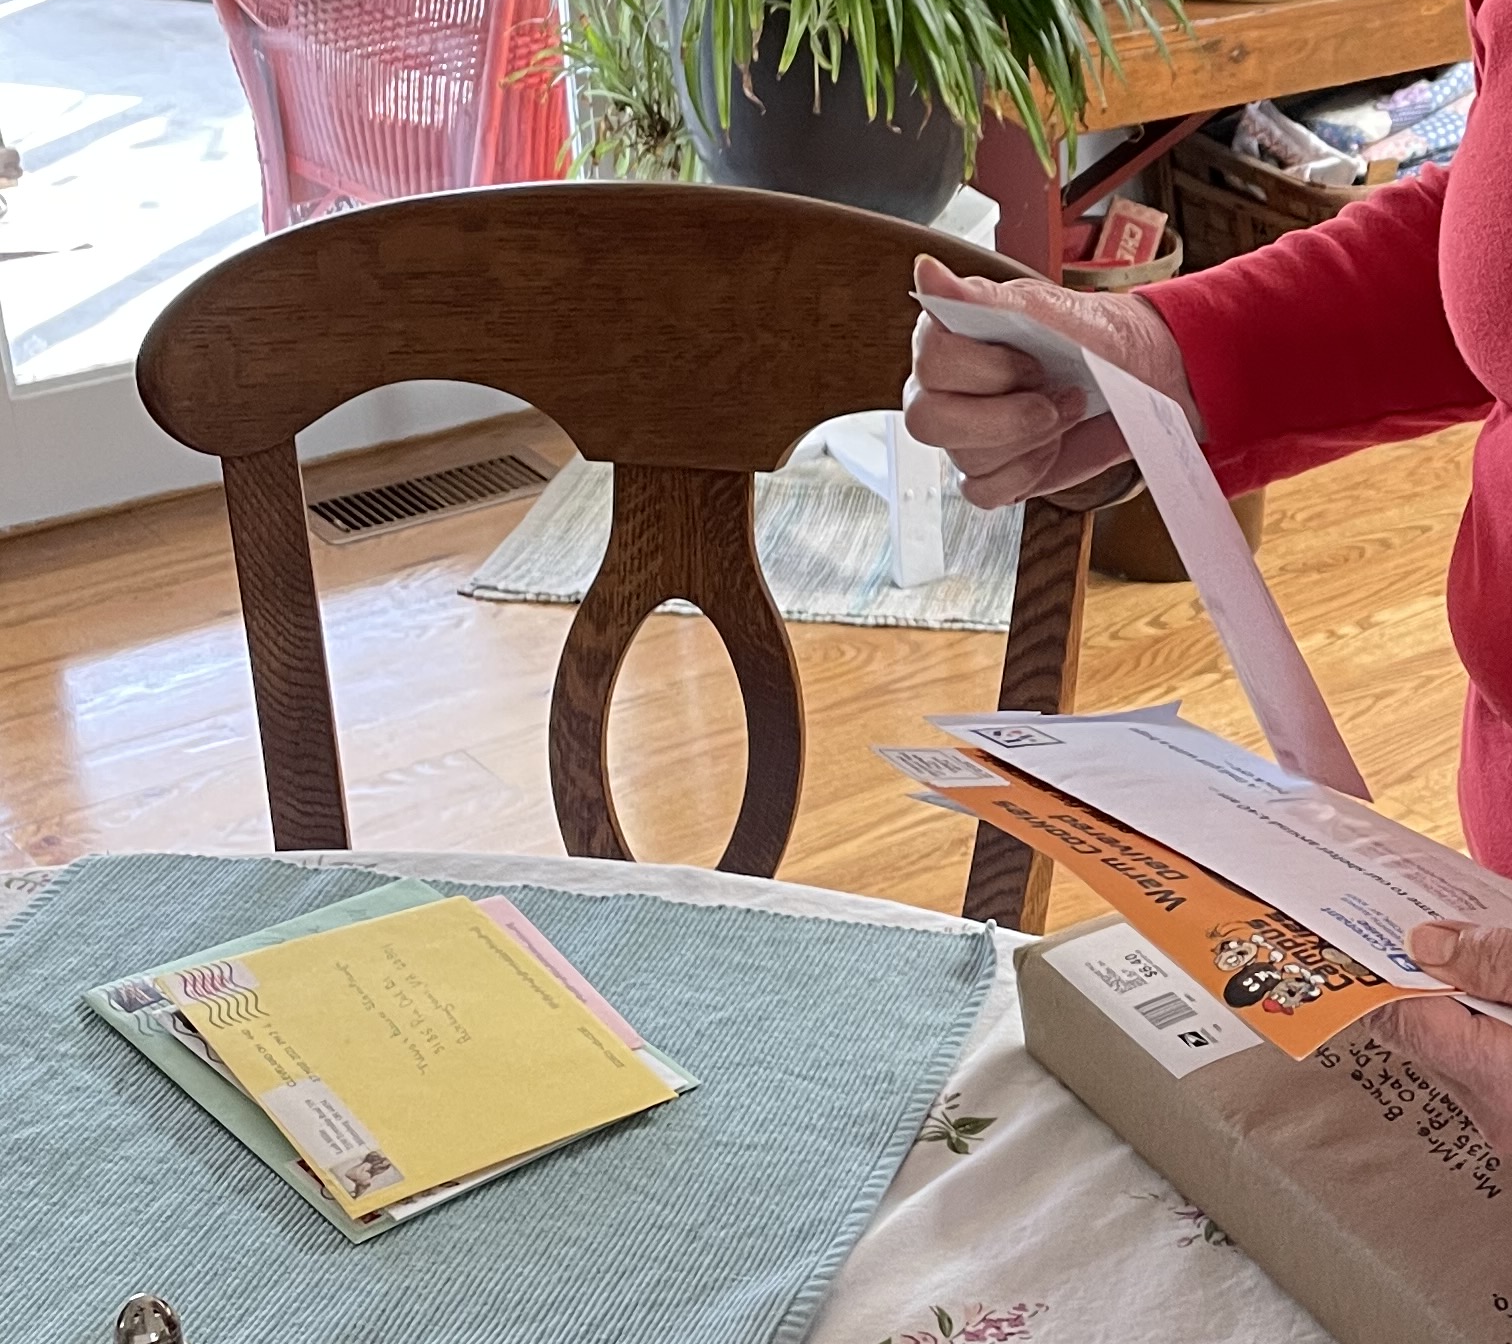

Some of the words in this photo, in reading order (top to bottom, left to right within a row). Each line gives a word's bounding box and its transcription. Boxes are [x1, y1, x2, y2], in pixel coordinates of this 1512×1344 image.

[992, 799, 1103, 855] Cookies
[1048, 813, 1189, 881] Delivered
[1101, 856, 1188, 912] Warm
[1320, 906, 1389, 953] Covenant
[1249, 918, 1355, 992] Campus
[1349, 1042, 1372, 1068] Dr.
[1364, 1038, 1392, 1064] VA
[1350, 1068, 1404, 1122] Bruce
[1377, 1067, 1415, 1103] Oak
[1422, 1102, 1450, 1131] Pin
[1453, 1134, 1501, 1172] 3135
[1472, 1166, 1502, 1199] Mr.
